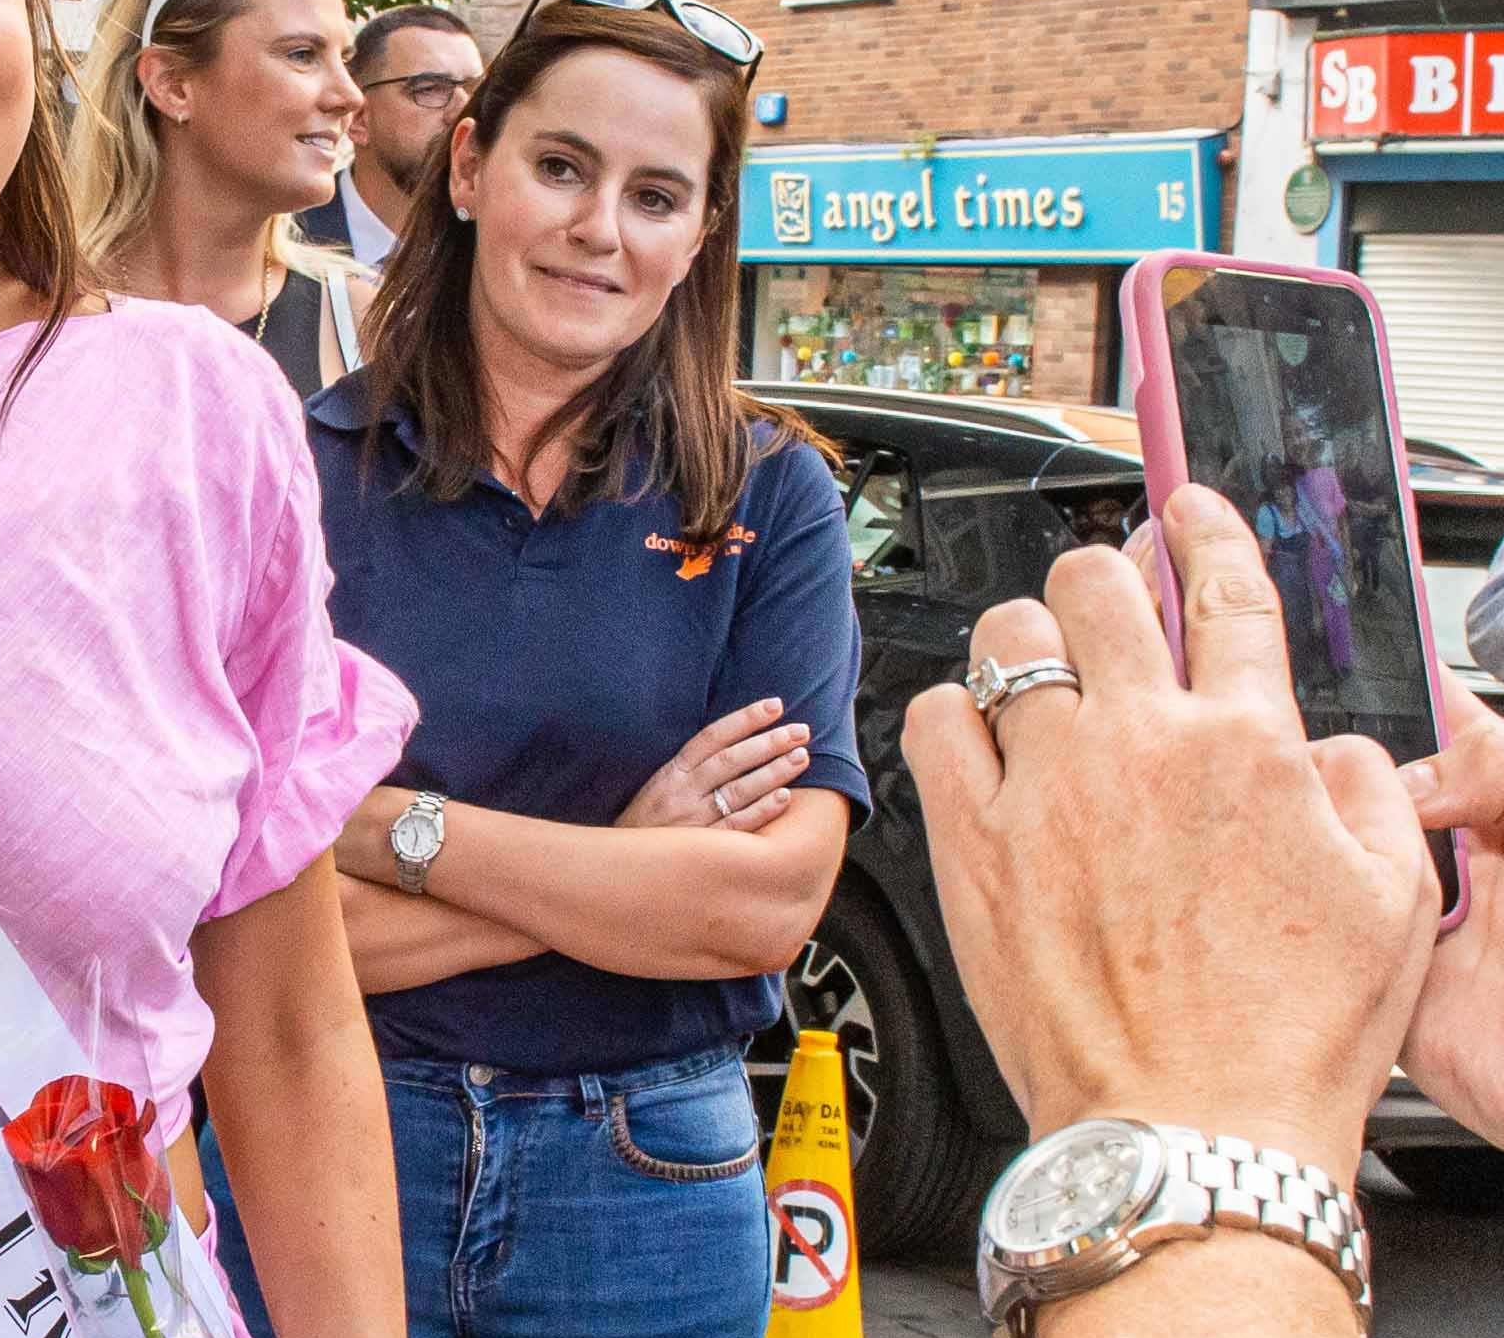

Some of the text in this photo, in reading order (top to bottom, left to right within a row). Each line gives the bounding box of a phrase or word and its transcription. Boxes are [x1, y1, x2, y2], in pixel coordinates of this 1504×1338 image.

[821, 169, 1186, 244] angel times 15
